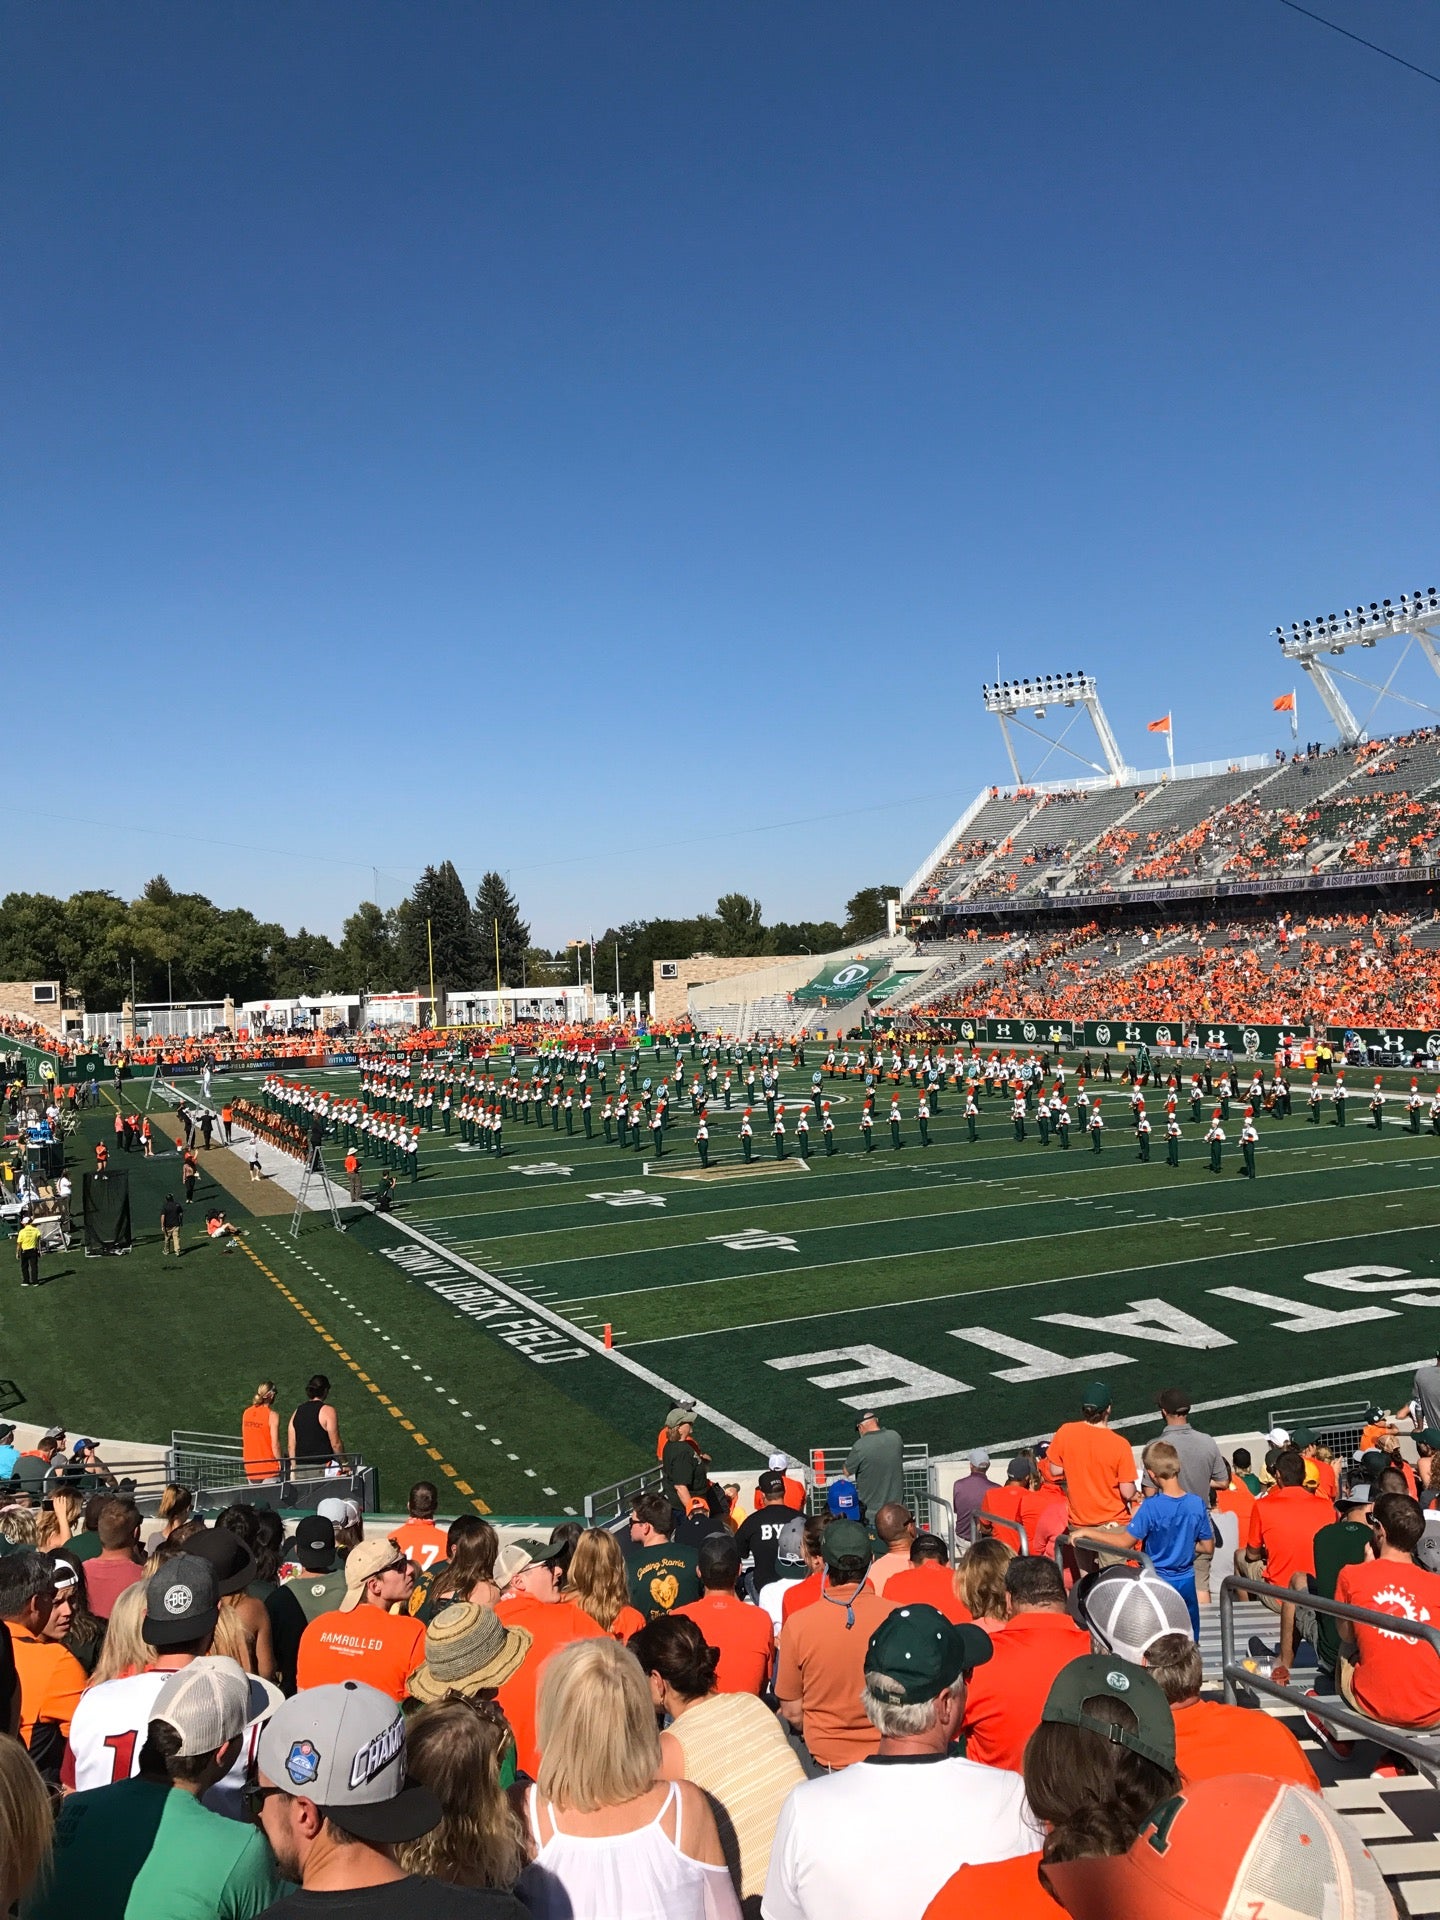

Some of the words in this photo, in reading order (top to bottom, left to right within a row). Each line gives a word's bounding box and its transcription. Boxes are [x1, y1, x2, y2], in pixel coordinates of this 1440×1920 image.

[1343, 873, 1380, 884] OFF-CAMPUS
[1380, 872, 1397, 882] GAME
[1398, 870, 1427, 881] CHANGER
[1146, 890, 1176, 900] OFF-CAMPUS
[1176, 889, 1190, 898] GAME
[1190, 887, 1213, 897] CHANGER
[975, 902, 1004, 911] OFF-CAMPUS
[1004, 901, 1018, 910] GAME
[1018, 900, 1040, 909] CHANGER
[328, 1056, 343, 1064] WITH
[344, 1055, 357, 1063] YOU
[585, 1189, 667, 1207] 20
[705, 1228, 799, 1251] 10
[378, 1244, 460, 1277] SONNY
[424, 1275, 524, 1321] LUBICK
[486, 1318, 590, 1364] FIELD
[763, 1265, 1440, 1410] STATE
[319, 1631, 383, 1651] RAMROLLED
[369, 1729, 387, 1747] ACC
